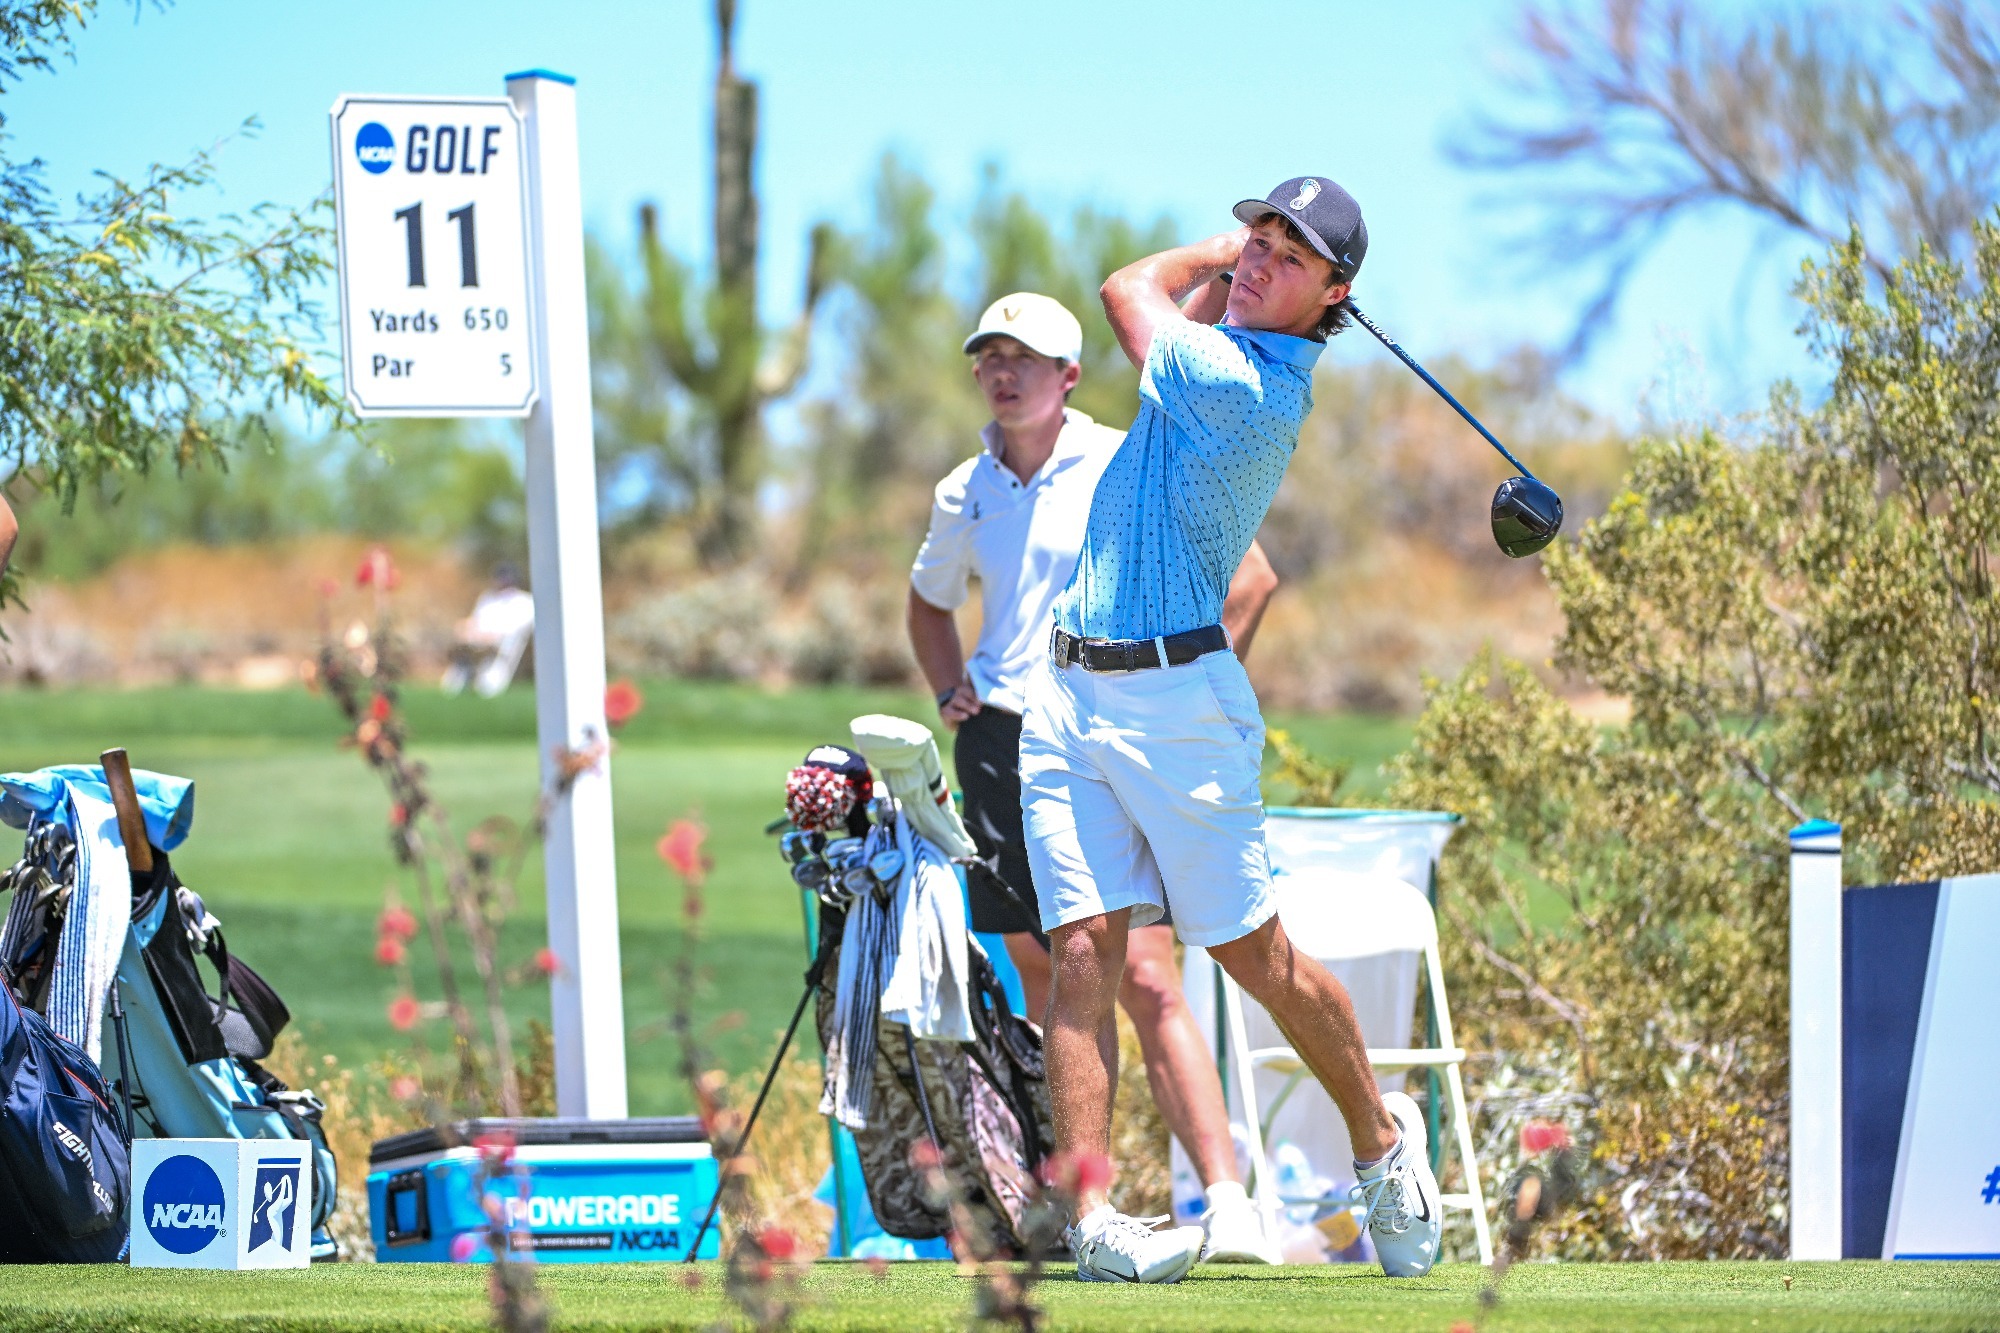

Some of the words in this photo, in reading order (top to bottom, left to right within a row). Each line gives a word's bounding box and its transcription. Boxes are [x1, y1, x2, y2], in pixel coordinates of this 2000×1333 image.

[406, 124, 502, 175] GOLF
[394, 200, 481, 289] 11
[370, 308, 439, 333] Yards
[464, 307, 508, 331] 650
[373, 353, 415, 378] Par
[501, 353, 512, 377] 5
[150, 1203, 221, 1229] NCAA
[505, 1194, 681, 1227] POWERADE
[619, 1231, 678, 1250] NCAA
